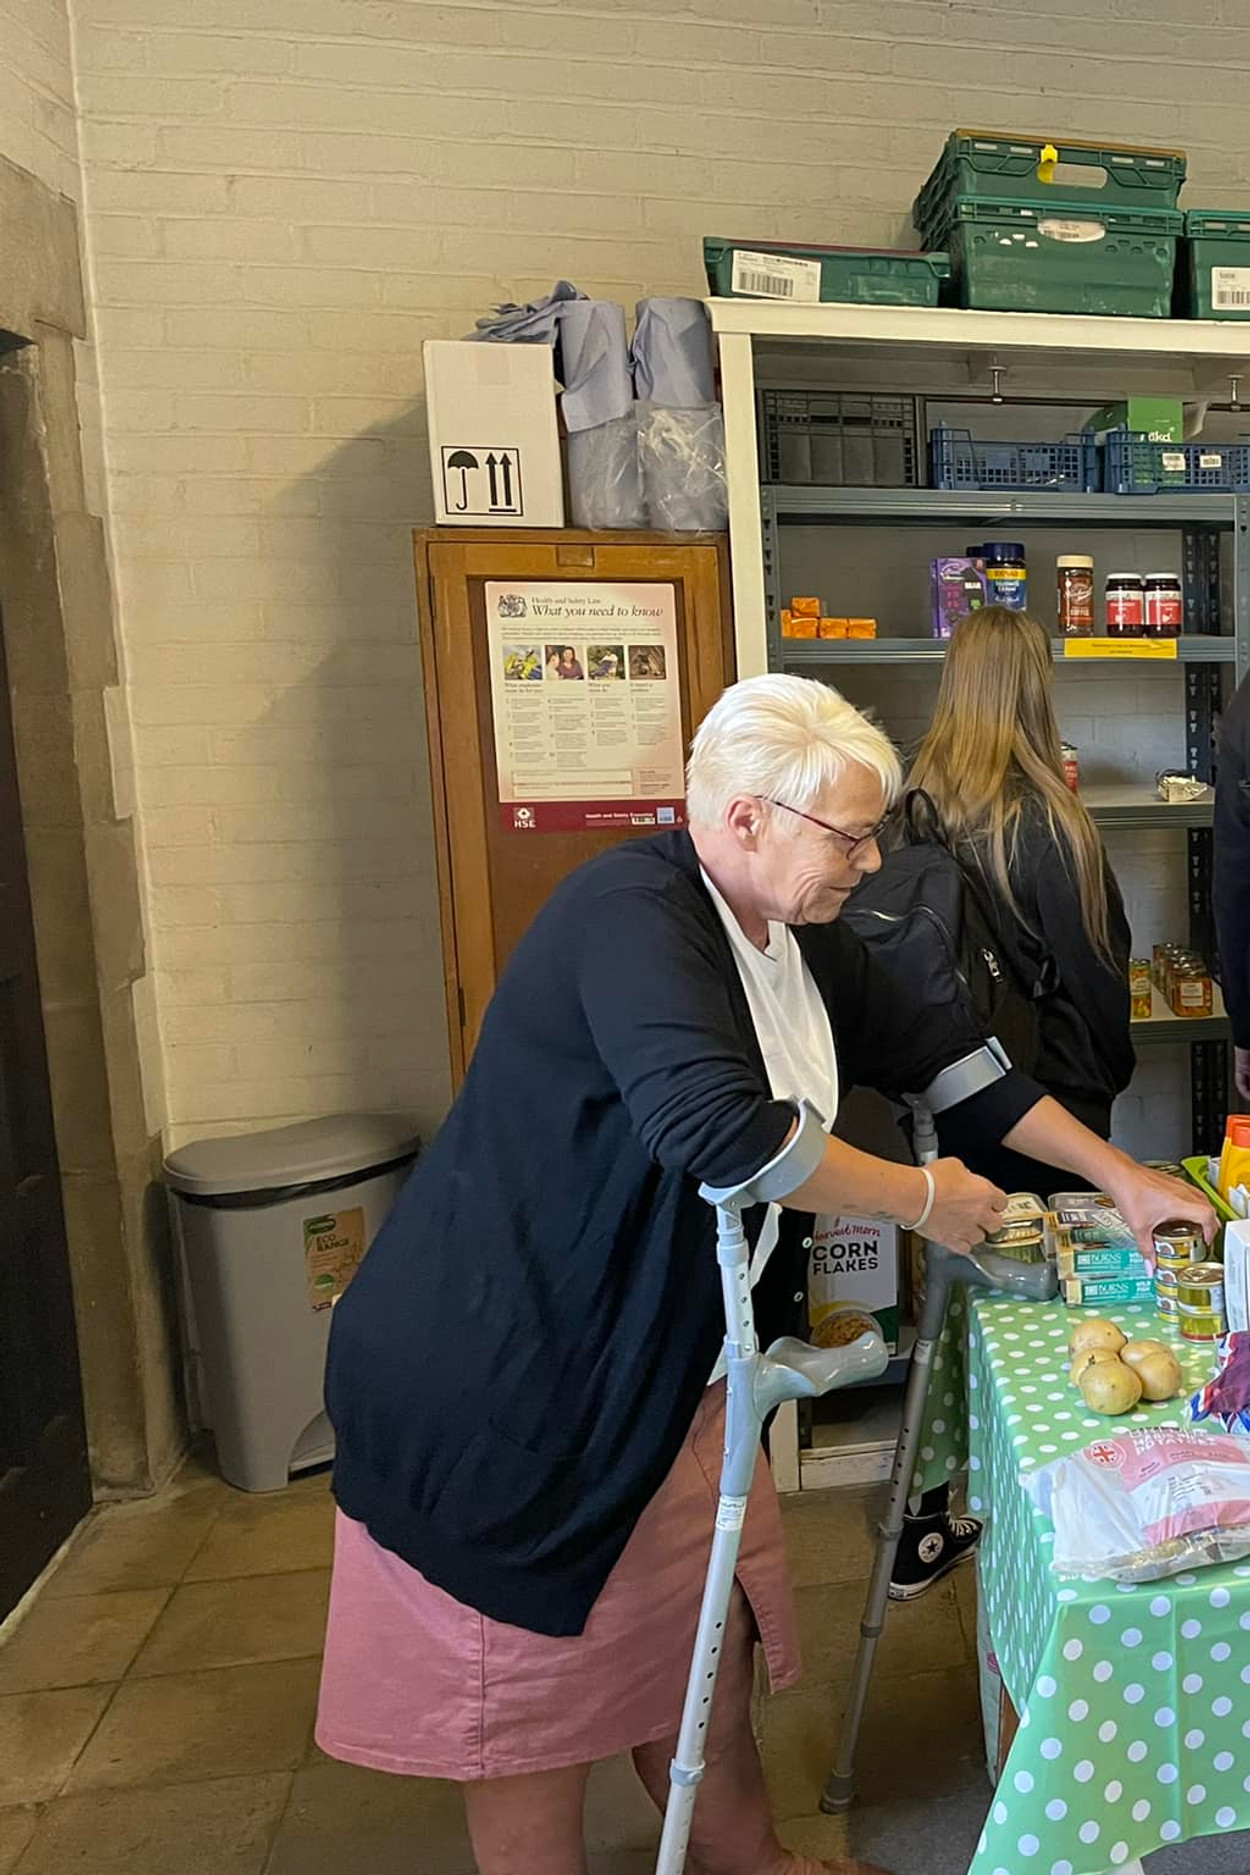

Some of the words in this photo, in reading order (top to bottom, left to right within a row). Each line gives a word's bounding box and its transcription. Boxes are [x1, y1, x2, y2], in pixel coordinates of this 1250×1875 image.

[533, 605, 562, 616] What
[564, 607, 586, 618] you
[588, 605, 614, 616] need
[617, 606, 629, 617] to
[631, 605, 663, 617] know
[514, 820, 536, 829] HSE
[813, 1240, 878, 1261] CORN
[813, 1257, 878, 1276] FLAKES
